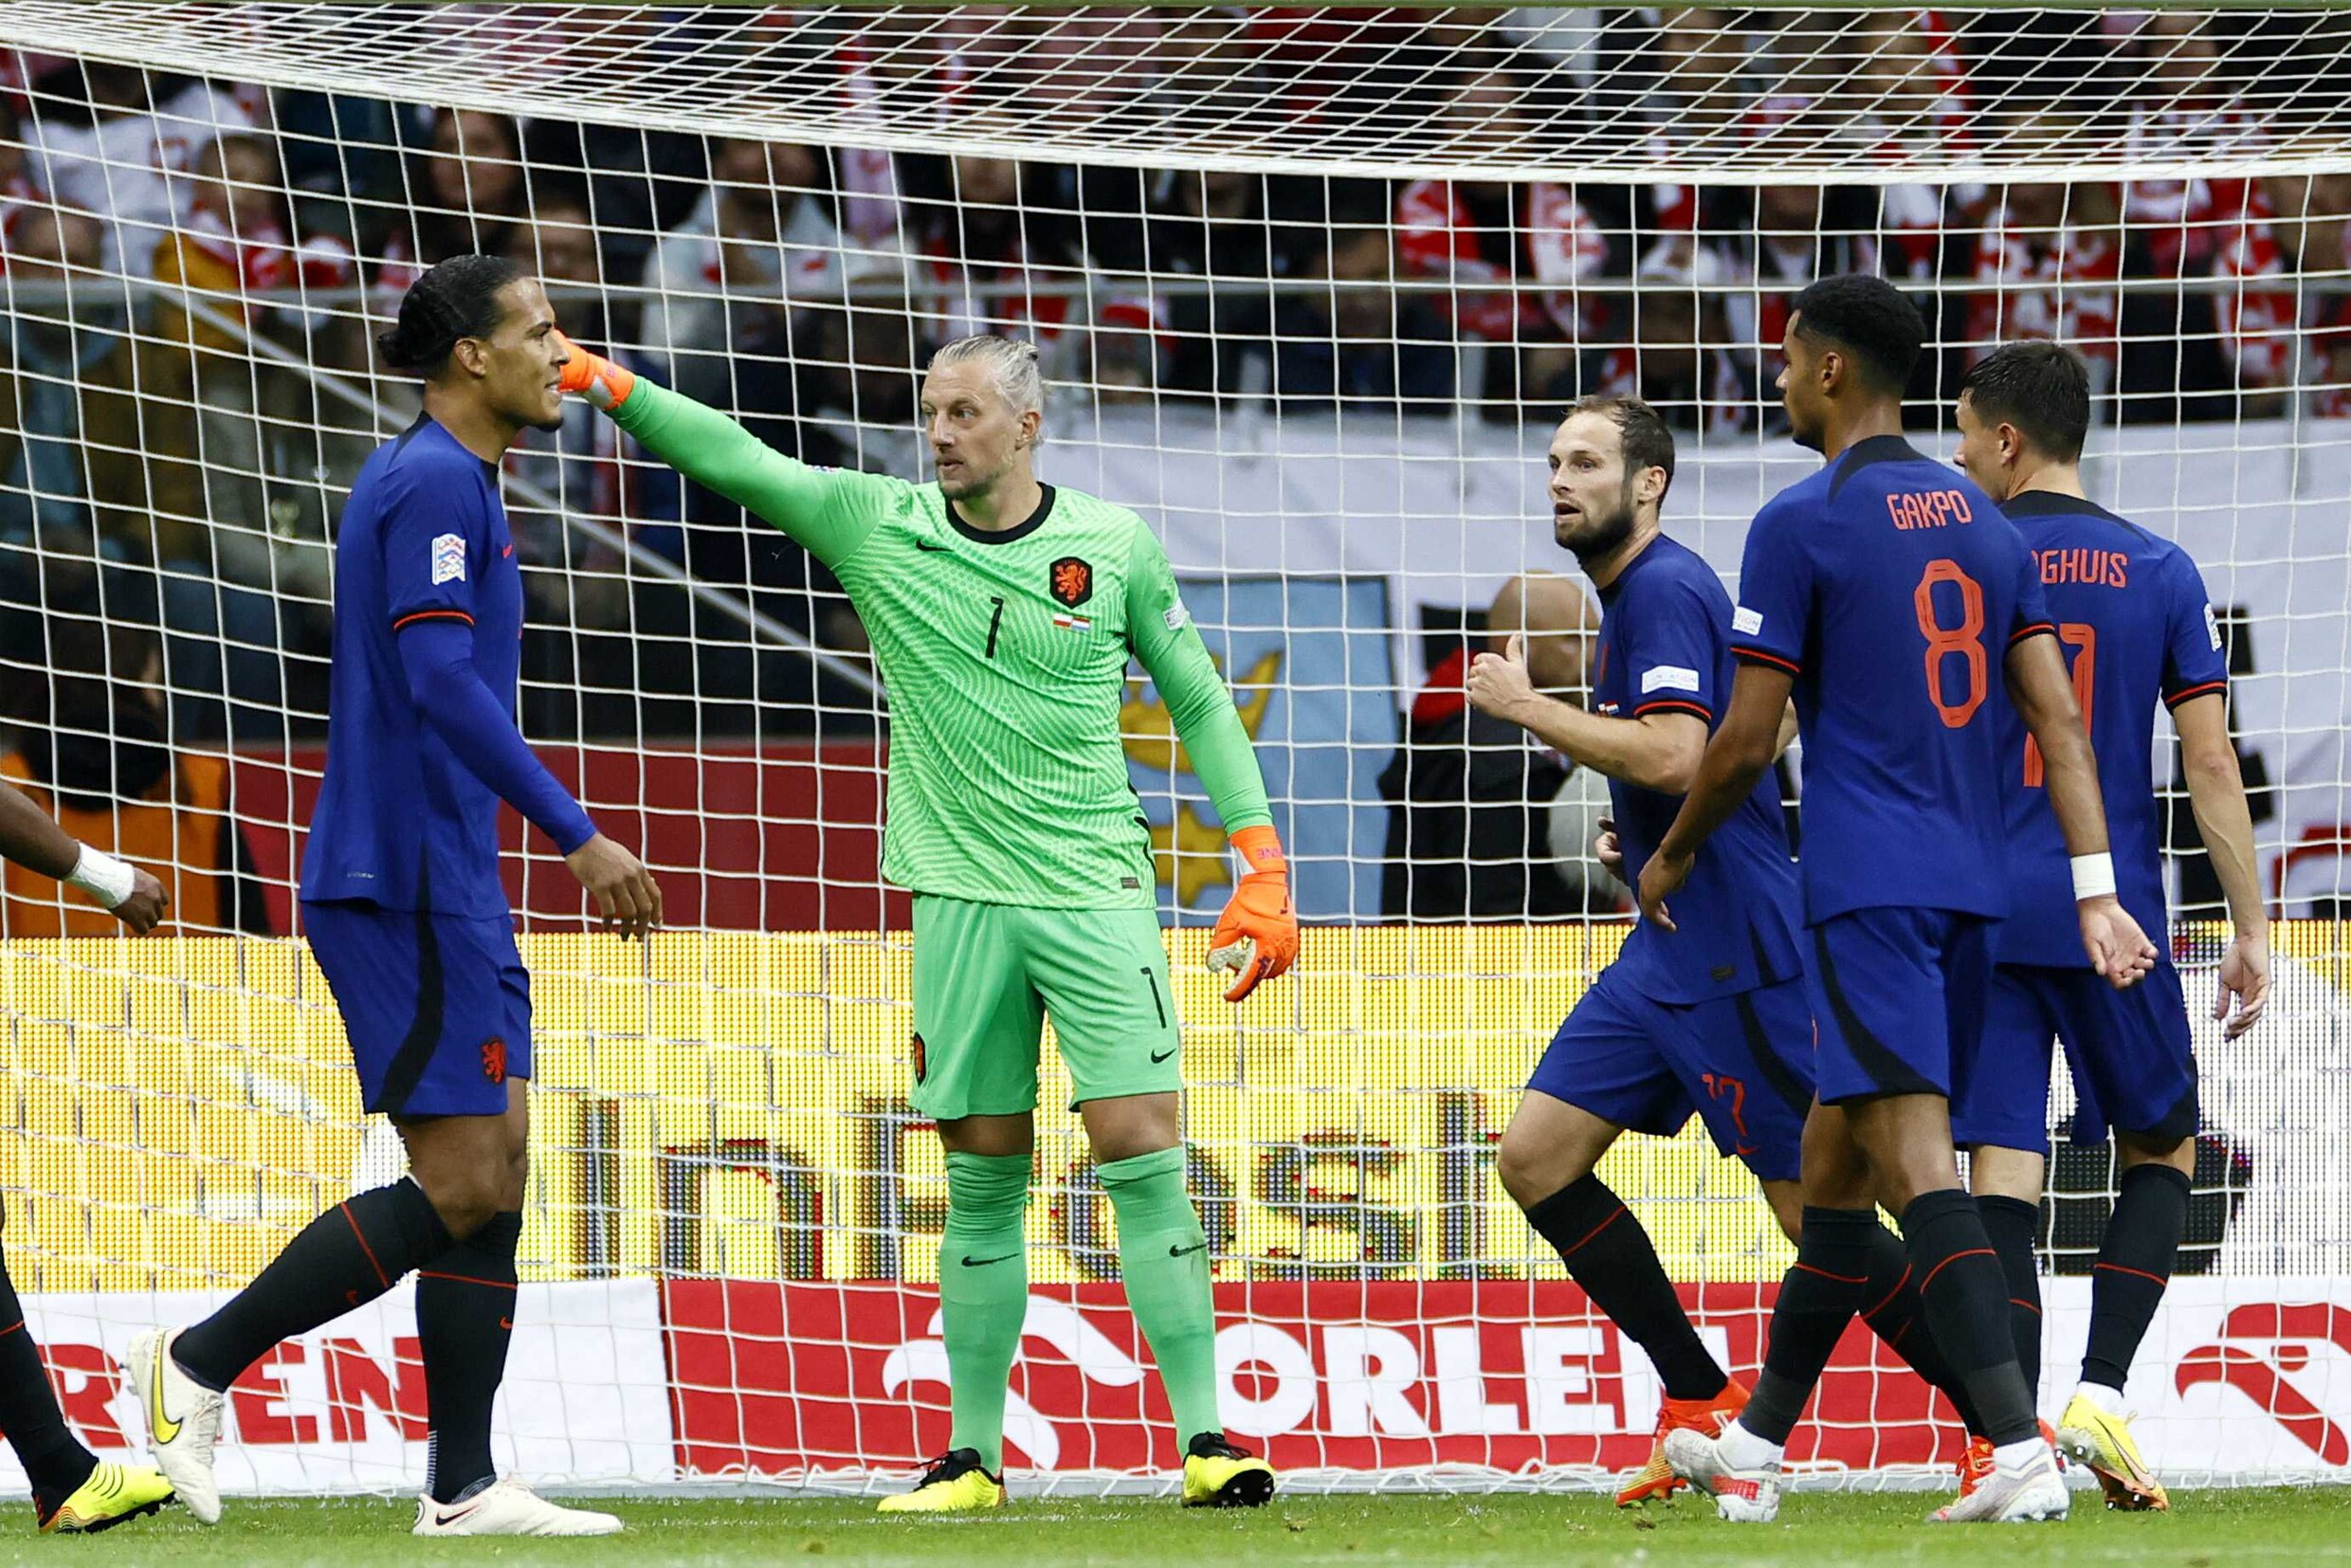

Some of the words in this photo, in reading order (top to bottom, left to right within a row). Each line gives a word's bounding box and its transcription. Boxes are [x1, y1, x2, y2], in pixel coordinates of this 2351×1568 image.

[1886, 489, 1973, 530] GAKPO
[986, 596, 1004, 659] 1
[1914, 558, 1988, 729] 8
[2023, 623, 2096, 788] 1
[1139, 966, 1167, 1030] 1
[0, 1336, 429, 1448] REN
